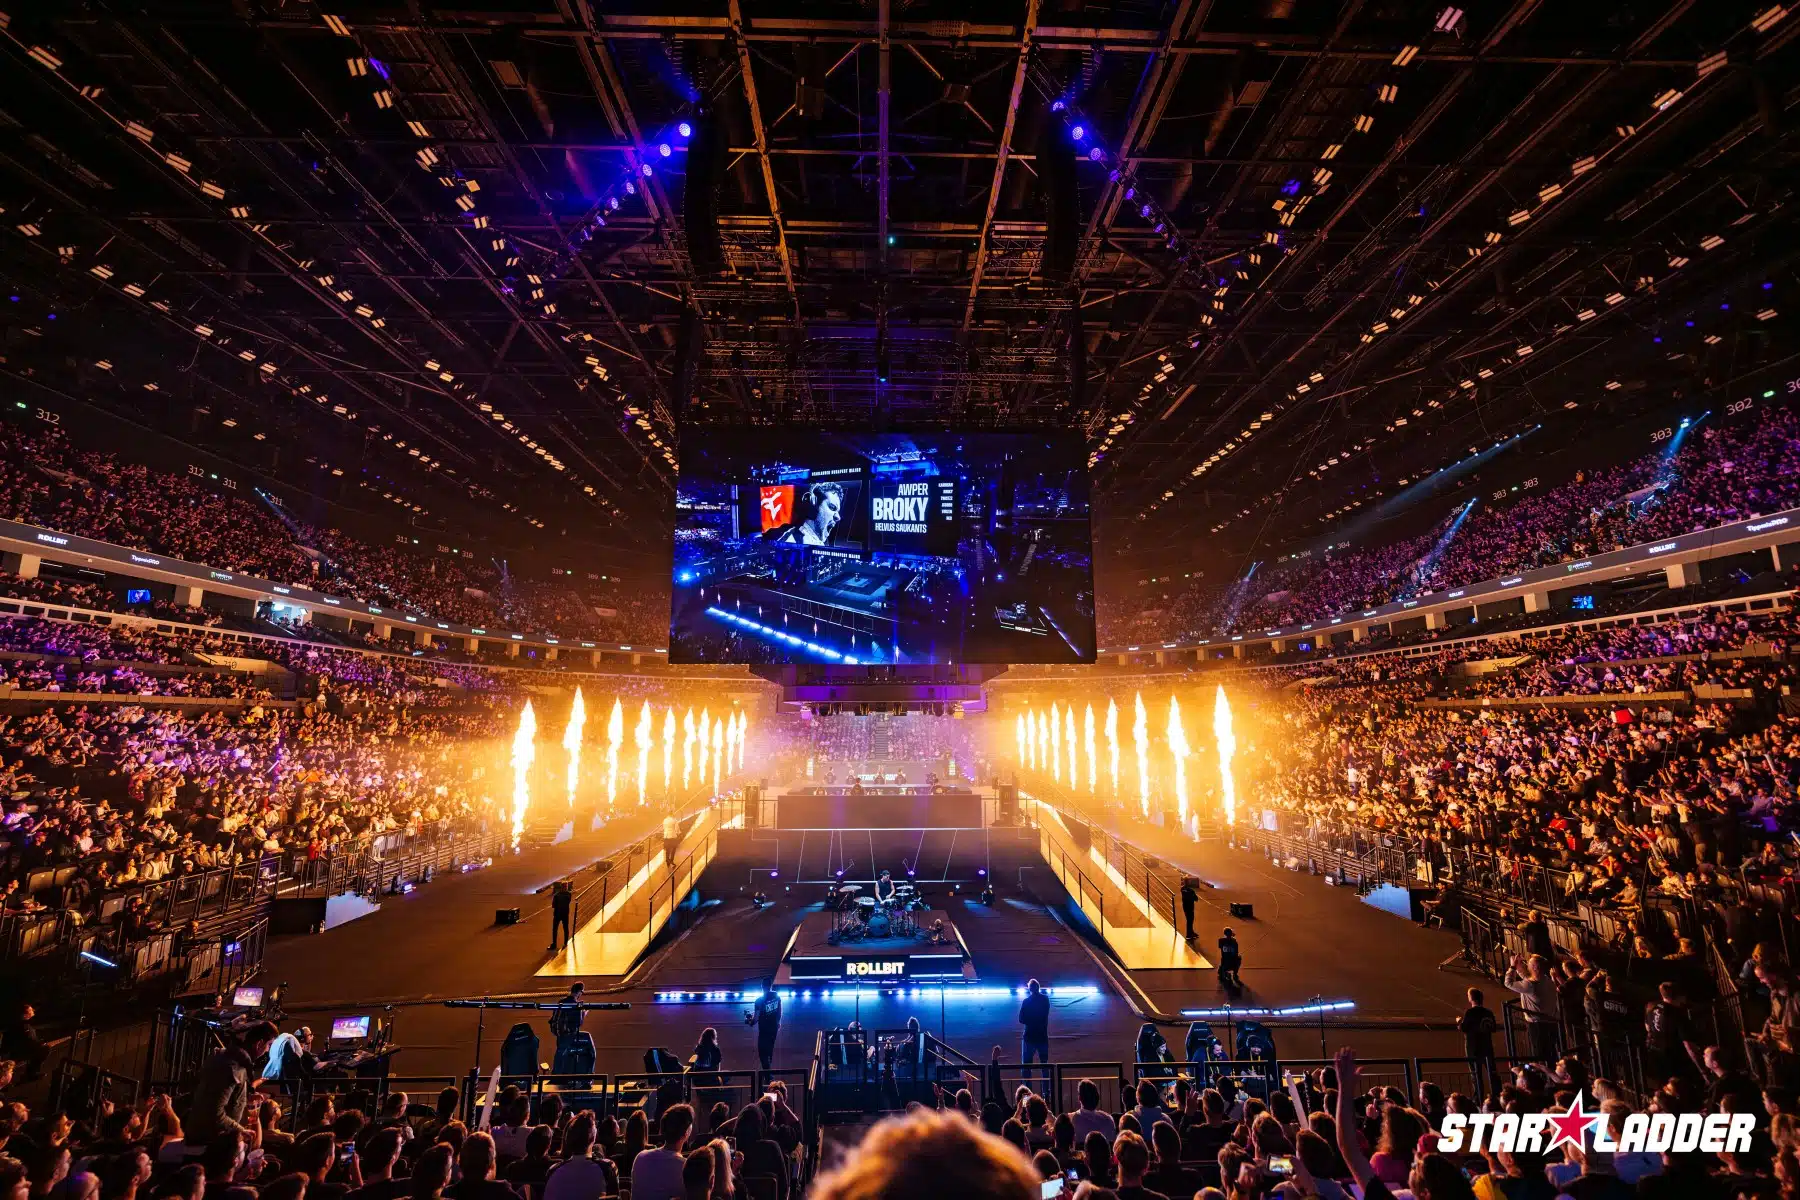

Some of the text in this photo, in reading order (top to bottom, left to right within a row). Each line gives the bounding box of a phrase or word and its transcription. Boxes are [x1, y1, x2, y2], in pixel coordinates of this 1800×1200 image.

[1726, 397, 1753, 416] 302
[36, 408, 60, 425] 312
[1650, 427, 1672, 443] 303
[188, 465, 204, 478] 312
[223, 478, 237, 490] 311
[897, 483, 929, 496] AWPER
[1523, 478, 1539, 489] 303
[1493, 489, 1507, 500] 303
[872, 497, 929, 521] BROKY
[896, 523, 928, 534] SAUKANTS
[38, 533, 68, 545] ROLLBIT
[1649, 542, 1676, 554] ROLLBIT
[846, 961, 905, 976] ROLLBIT
[1603, 1000, 1628, 1015] CREW
